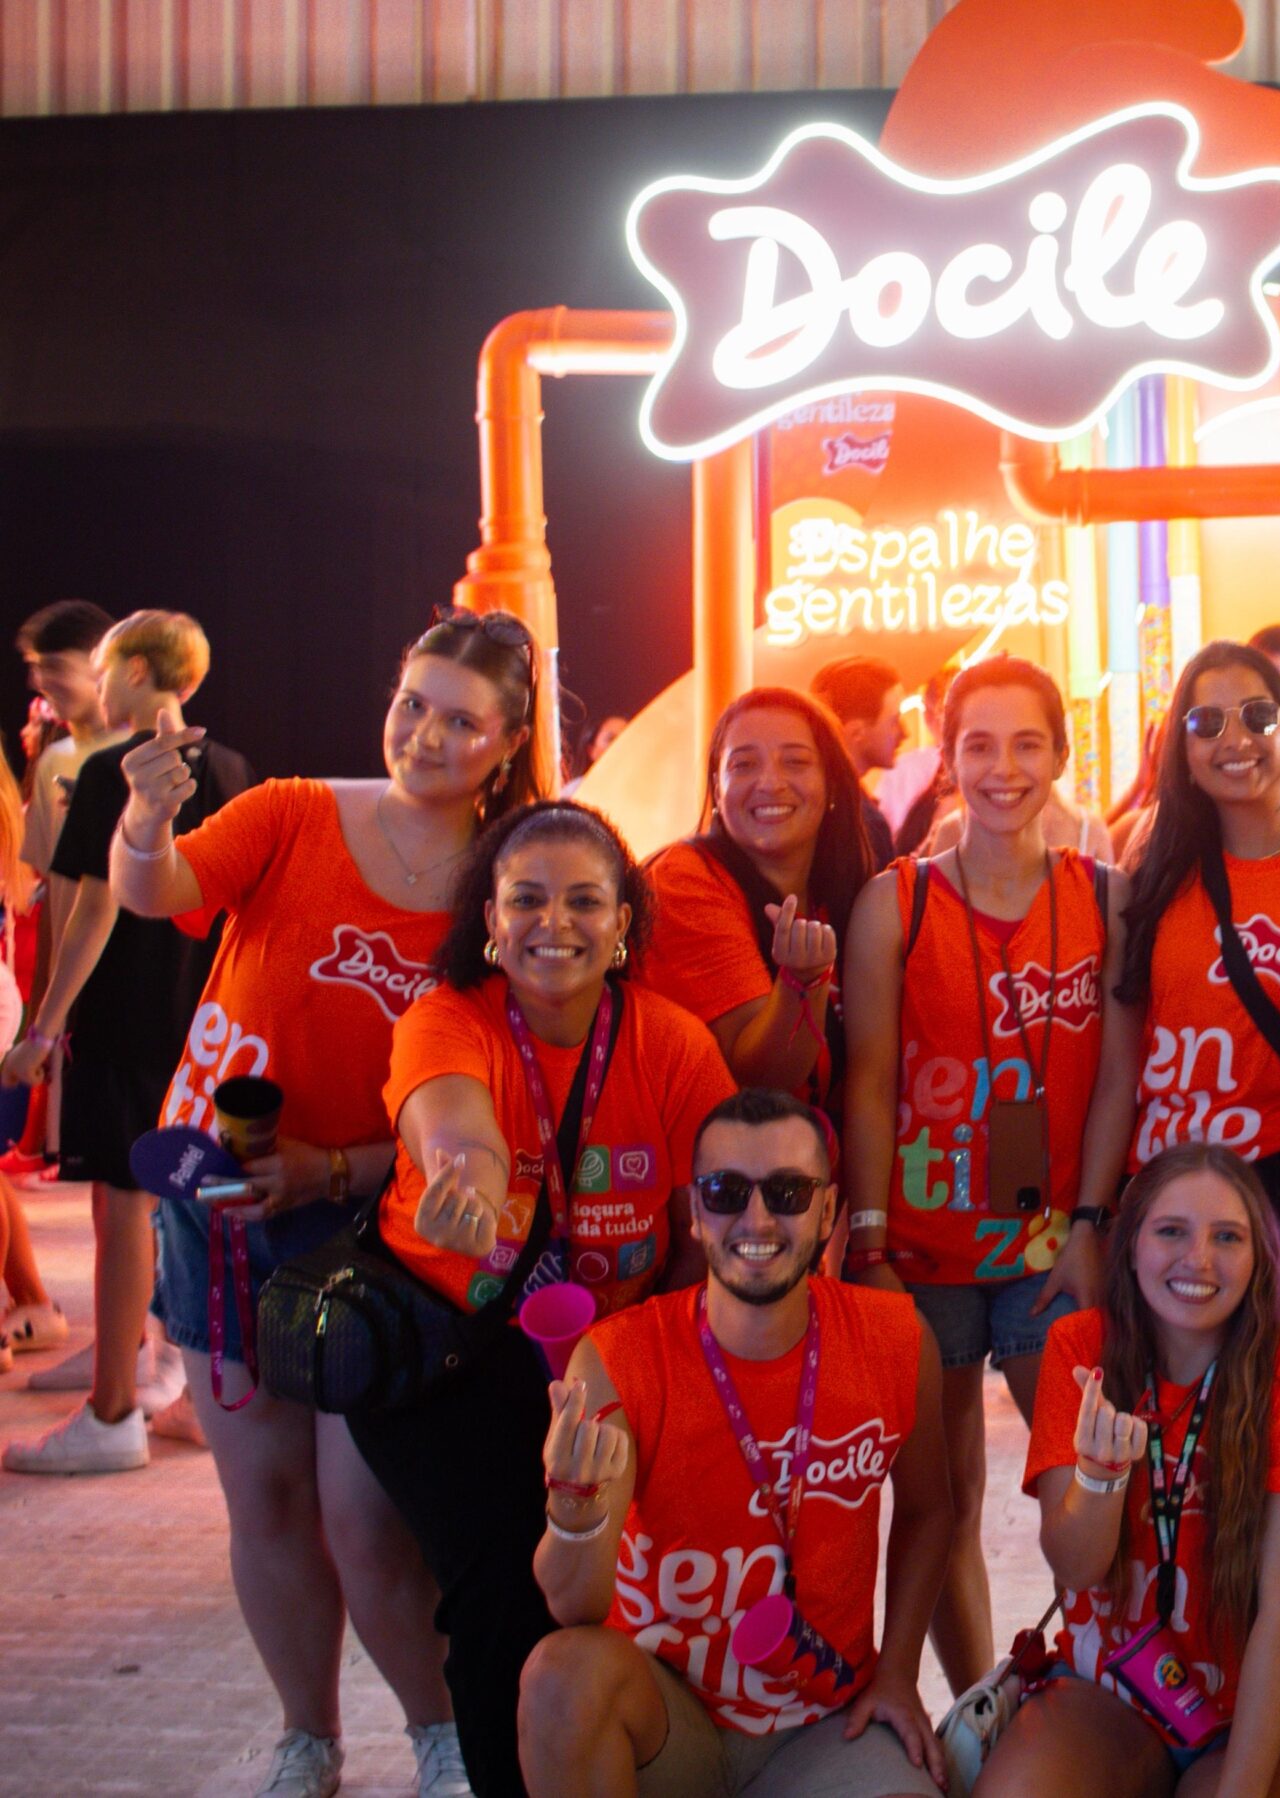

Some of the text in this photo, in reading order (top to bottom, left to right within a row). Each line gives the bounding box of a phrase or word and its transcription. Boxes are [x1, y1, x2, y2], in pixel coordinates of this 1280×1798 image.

[708, 163, 1225, 390] Docile
[786, 510, 1036, 579] Espalhe
[764, 573, 1070, 645] gentilezas
[337, 938, 438, 1001] Docil
[1016, 975, 1098, 1024] Docile
[904, 1048, 1032, 1126] en
